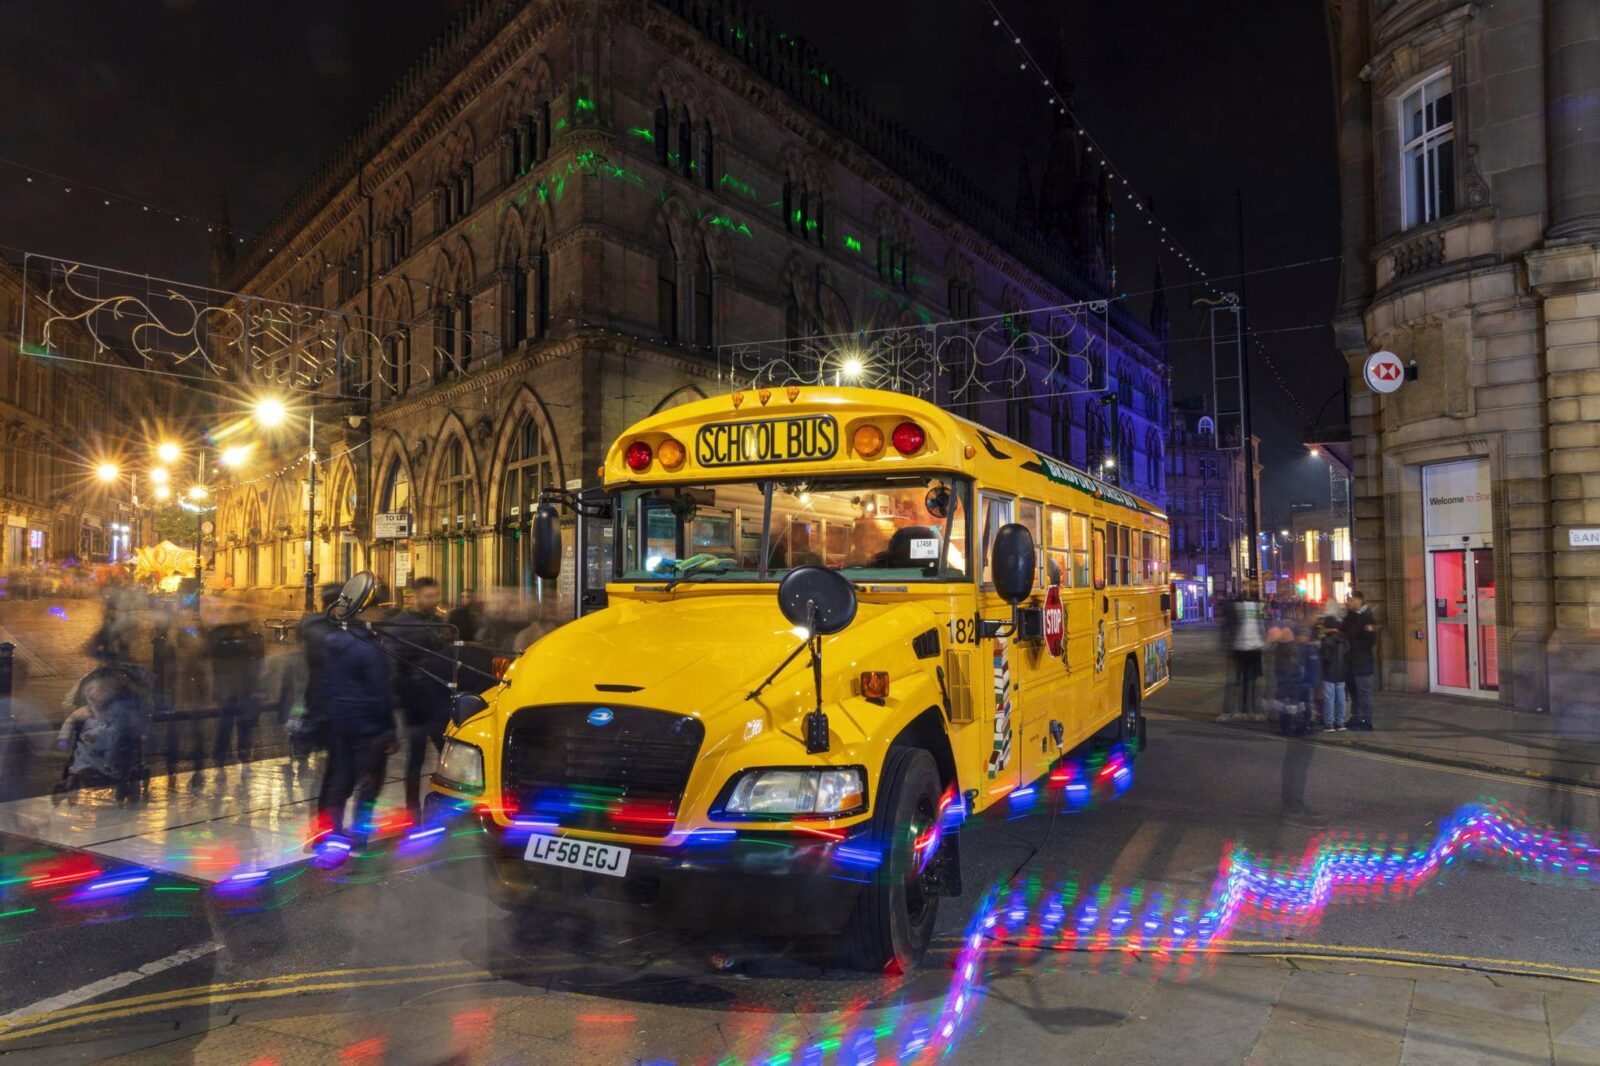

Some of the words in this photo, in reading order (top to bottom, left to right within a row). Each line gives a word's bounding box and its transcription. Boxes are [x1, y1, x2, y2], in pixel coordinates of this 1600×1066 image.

[701, 422, 782, 462] SCHOOL
[787, 418, 833, 457] BUS
[1430, 496, 1465, 505] Welcome
[1466, 495, 1474, 503] to
[1573, 533, 1600, 542] BAN
[946, 618, 975, 644] 182
[1046, 608, 1061, 634] STOP
[533, 838, 581, 864] LF58
[582, 846, 621, 871] EGJ
